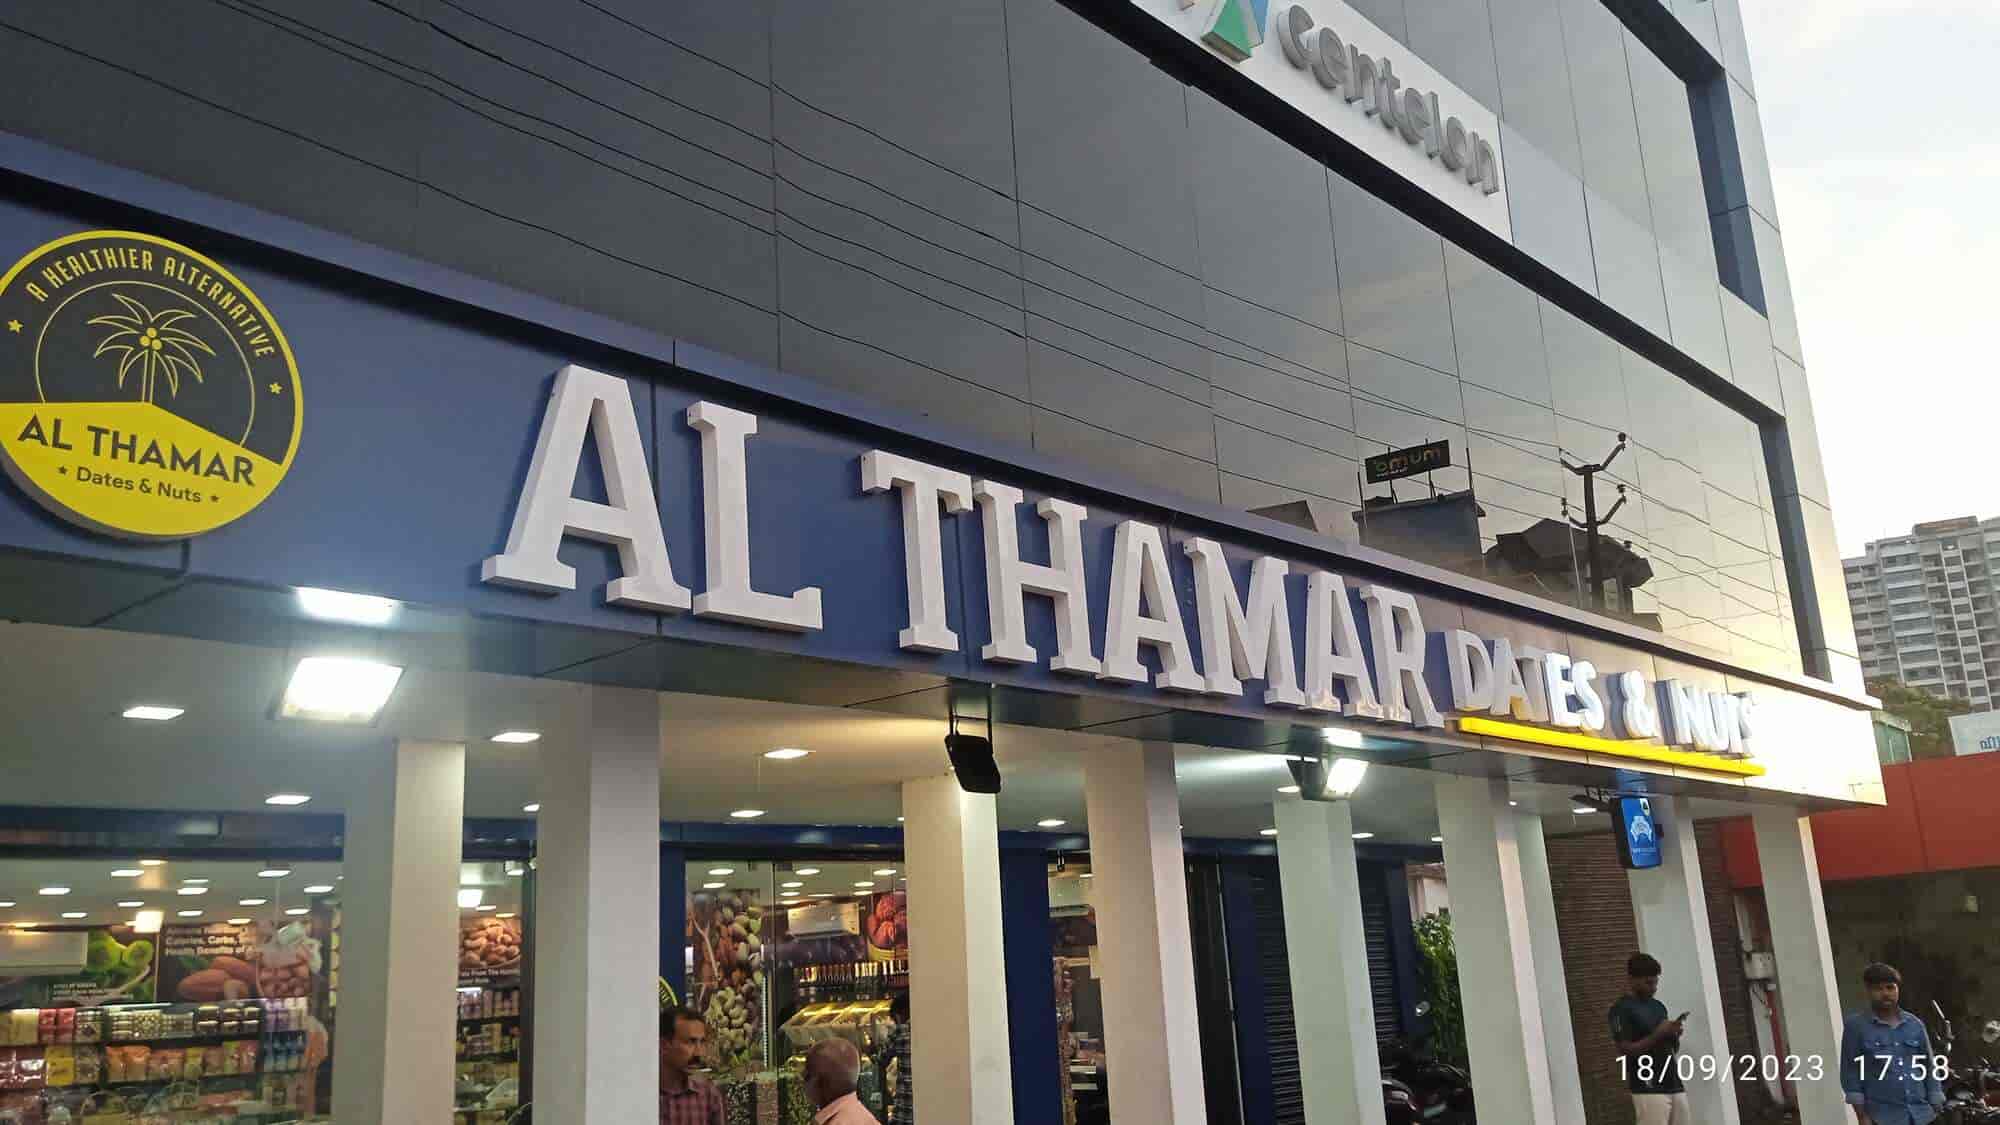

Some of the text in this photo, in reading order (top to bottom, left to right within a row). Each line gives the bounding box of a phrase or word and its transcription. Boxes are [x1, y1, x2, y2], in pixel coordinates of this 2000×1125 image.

[1277, 4, 1500, 196] centelon
[26, 247, 275, 357] A HEALTHIER ALTERNATIVE
[18, 413, 256, 487] AL THAMAR
[76, 466, 202, 503] Dates & Nuts
[480, 364, 1445, 729] AL THAMAR
[1444, 629, 1757, 757] DATES & NUTS
